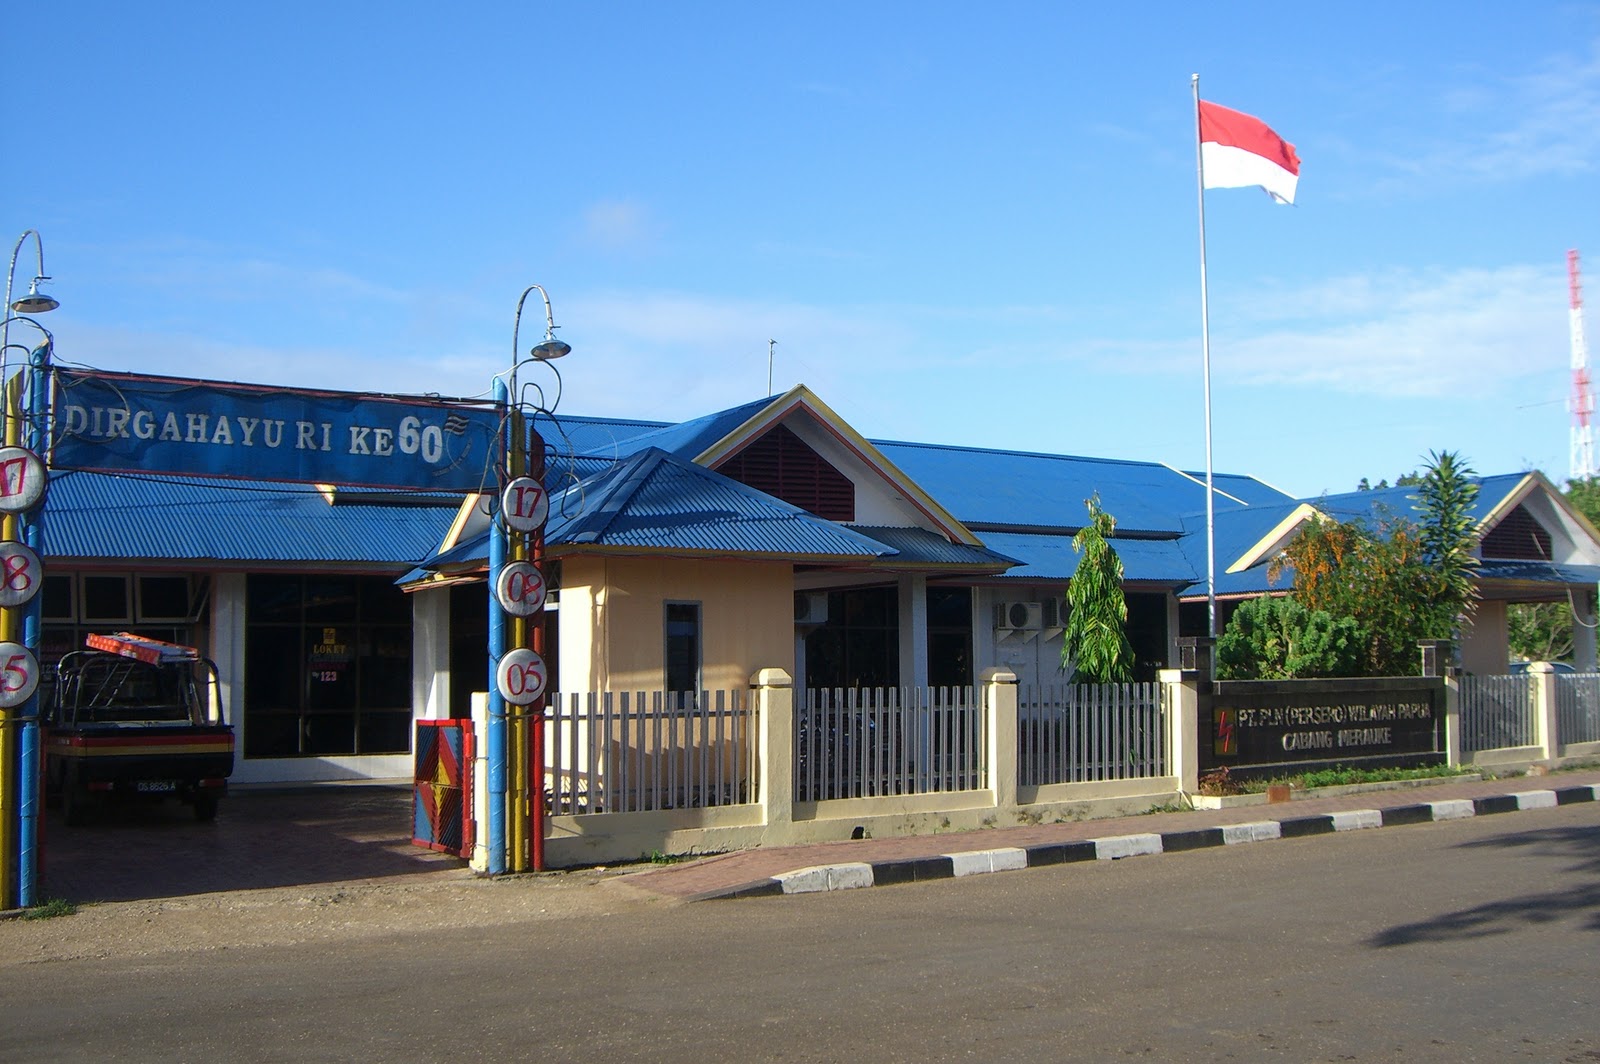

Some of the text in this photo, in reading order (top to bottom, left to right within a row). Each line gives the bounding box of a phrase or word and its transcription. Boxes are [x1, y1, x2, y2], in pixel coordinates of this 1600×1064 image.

[64, 405, 285, 448] DIRGAHAYU
[295, 421, 332, 451] RI
[349, 426, 394, 456] KE
[399, 416, 443, 463] 60
[510, 486, 542, 519] 17
[507, 571, 542, 605] 08
[313, 644, 346, 654] LOKET
[0, 655, 28, 693] 5
[320, 671, 337, 682] 123
[506, 661, 542, 695] 05
[1285, 704, 1347, 726] (PERSERO)
[1348, 704, 1396, 722] WILAYAH
[1398, 702, 1431, 719] PAPUA
[1282, 727, 1392, 751] CABANG MERAUKE
